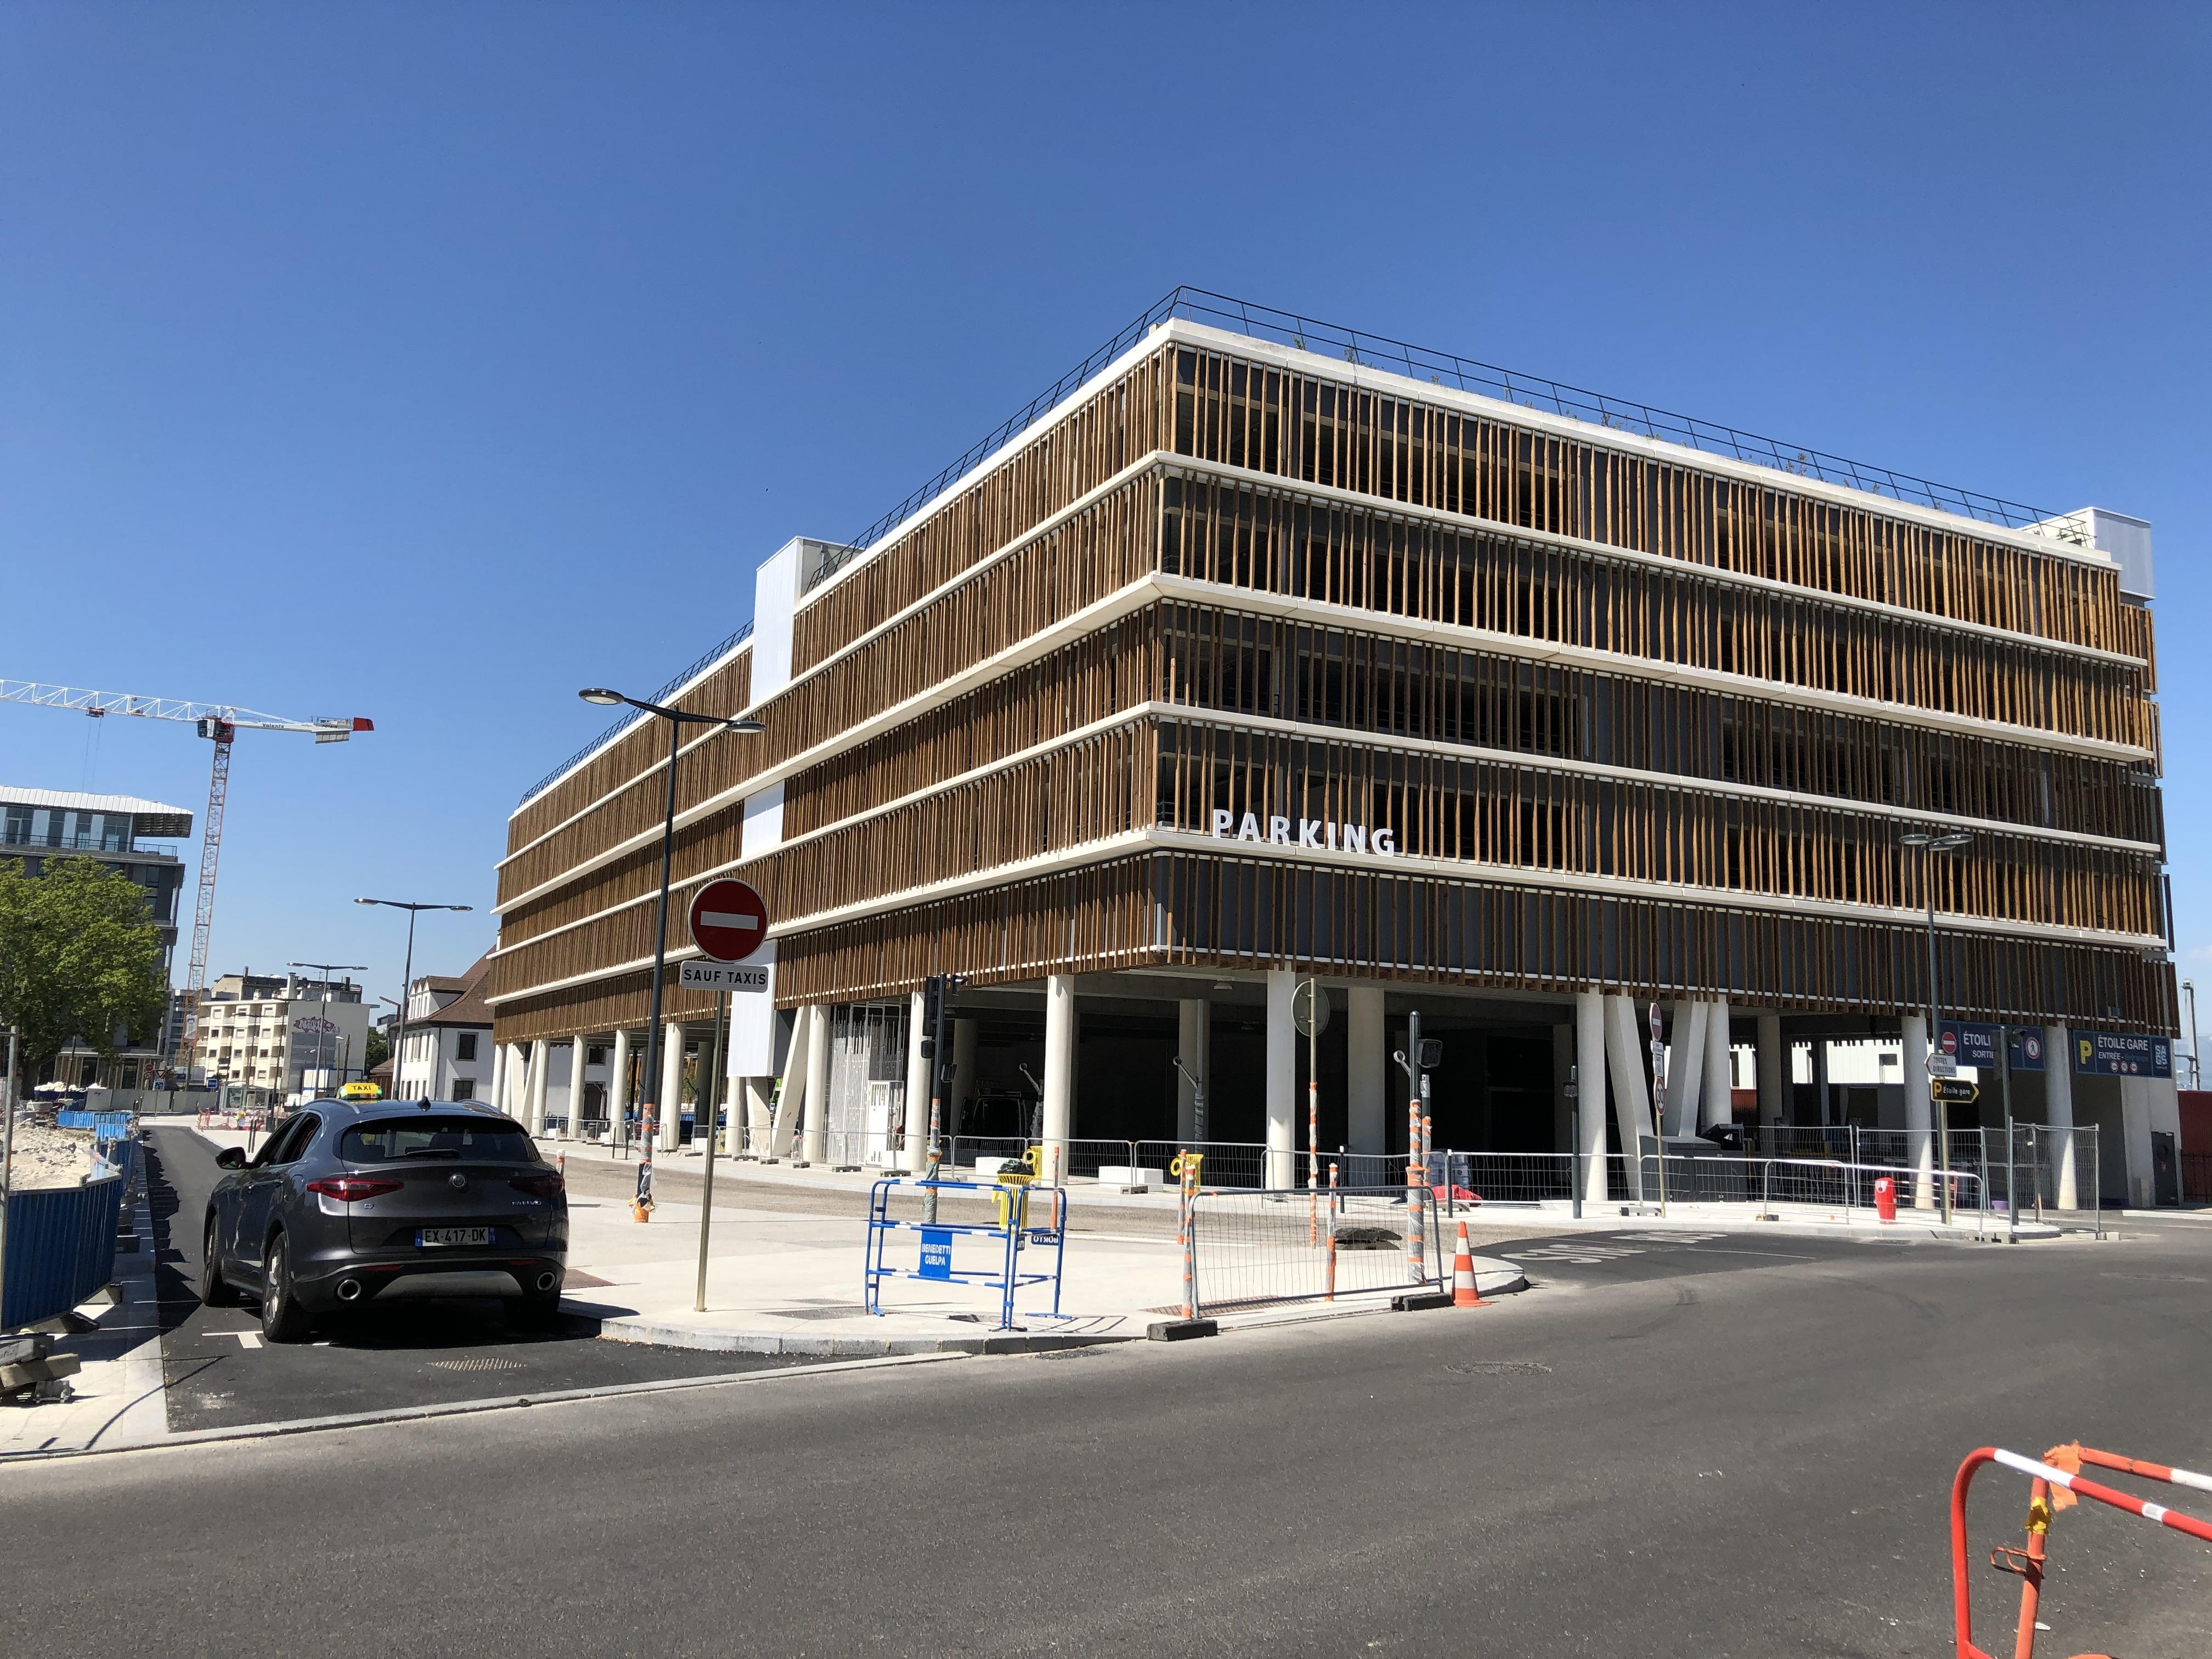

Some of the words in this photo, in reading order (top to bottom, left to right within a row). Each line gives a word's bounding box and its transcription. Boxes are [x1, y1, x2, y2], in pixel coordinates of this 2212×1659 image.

[1212, 809, 1395, 857] PARKING
[684, 969, 721, 982] SAUF
[727, 972, 766, 985] TAXIS
[1963, 1031, 1991, 1046] ÉTOIL
[2097, 1035, 2125, 1049] ÉTOILE
[2126, 1040, 2149, 1051] GARE
[2080, 1040, 2092, 1064] P
[1934, 1082, 1942, 1097] P
[425, 1229, 486, 1243] EX-417-DK
[922, 1243, 951, 1255] BENEDETTI
[924, 1255, 946, 1266] GUELPA
